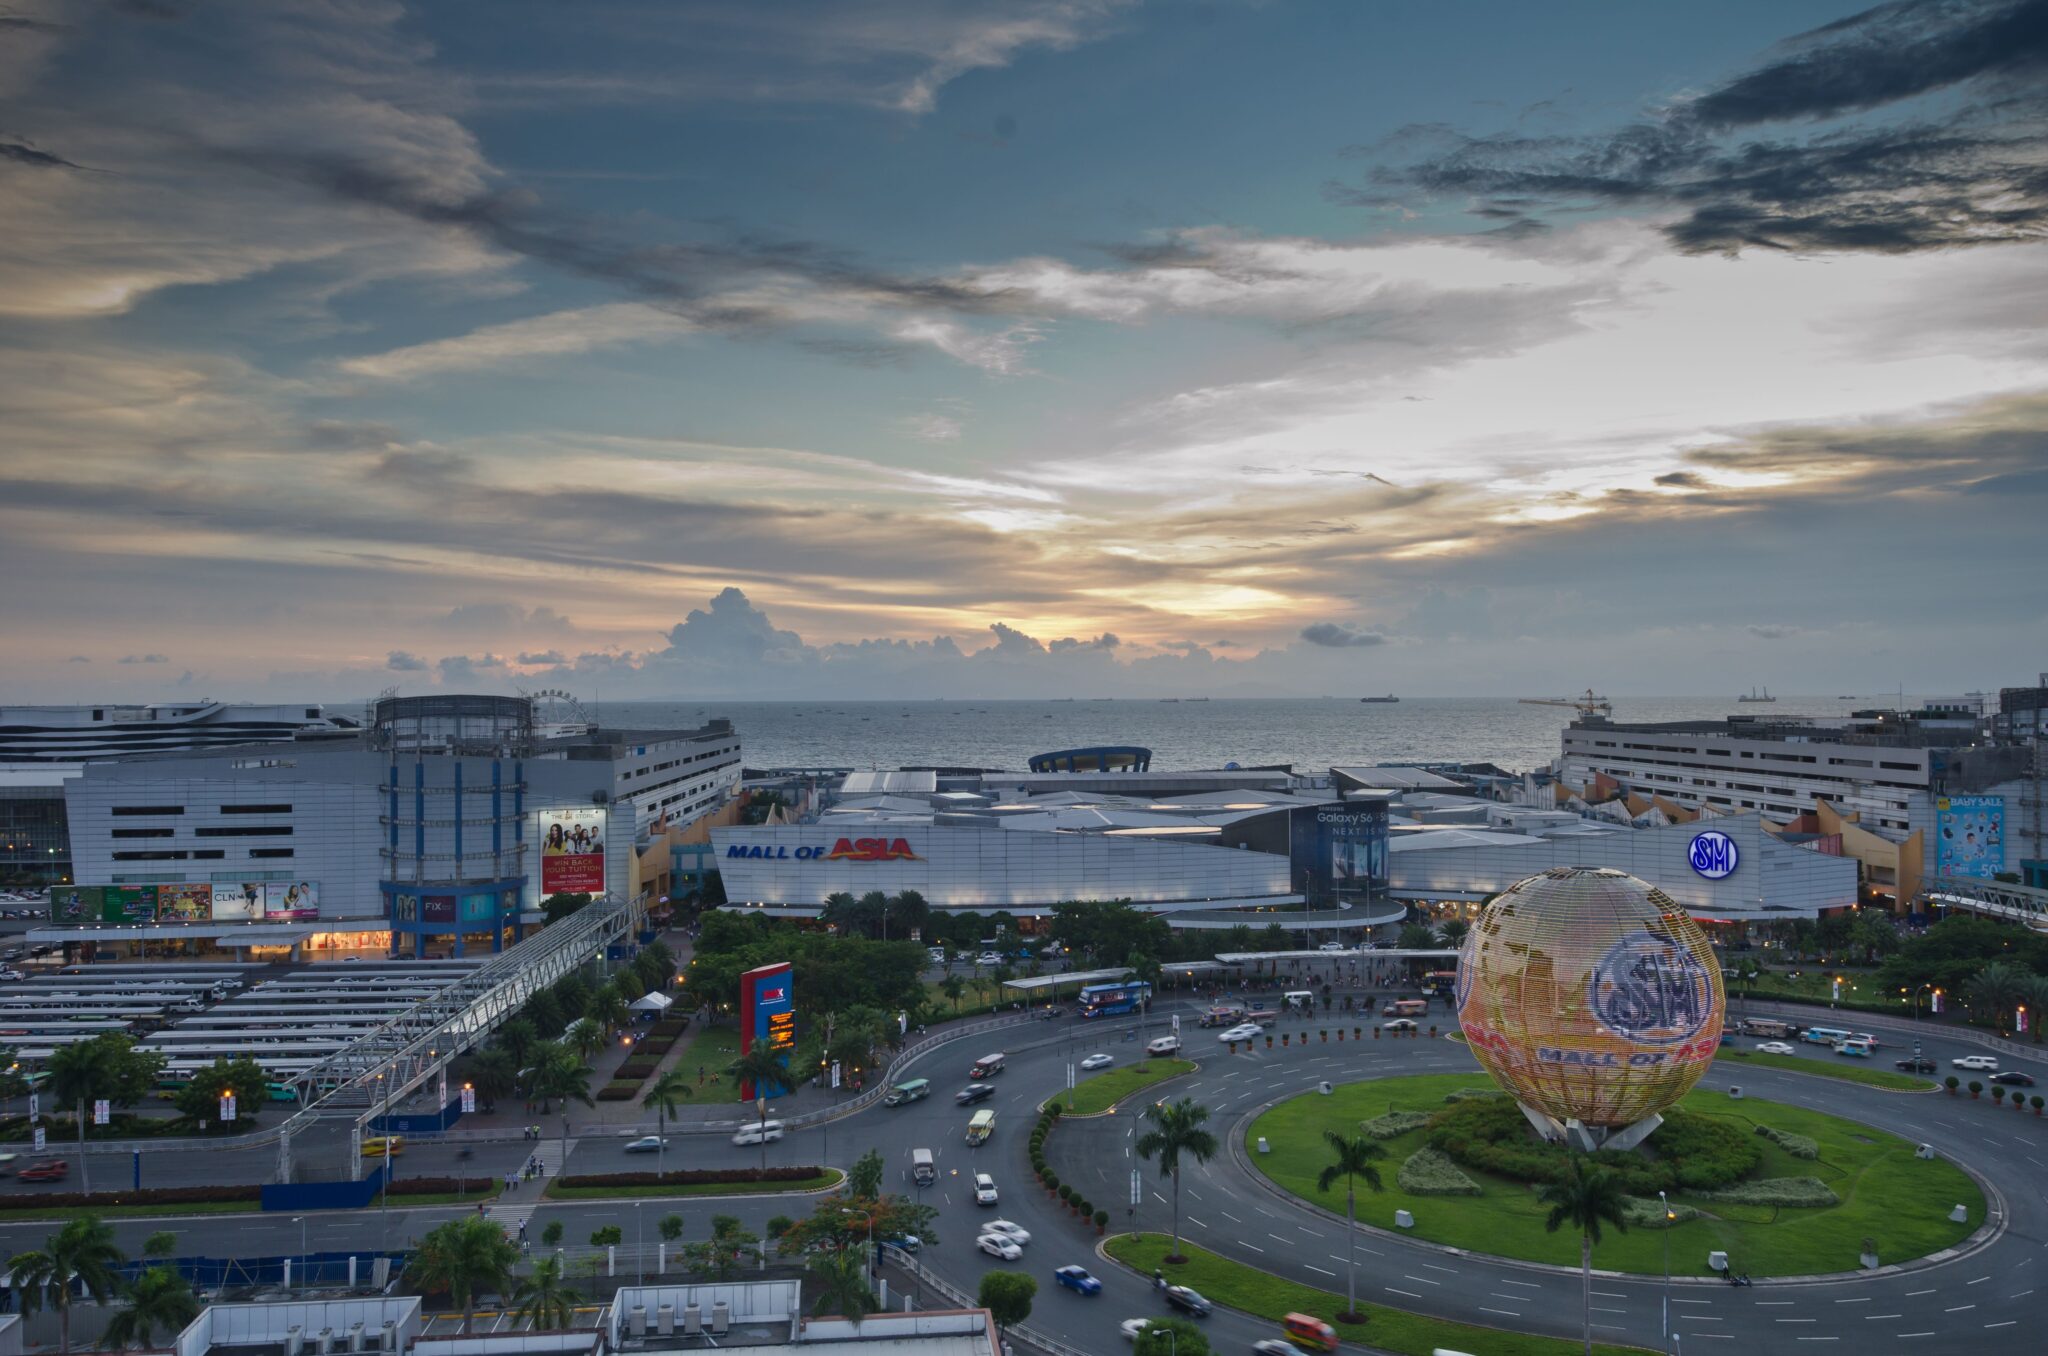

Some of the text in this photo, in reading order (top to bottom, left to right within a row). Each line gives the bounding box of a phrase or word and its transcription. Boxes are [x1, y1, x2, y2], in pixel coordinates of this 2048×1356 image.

[1950, 797, 1977, 806] BABY
[1978, 797, 2003, 806] SALE
[1317, 812, 1359, 826] Galaxy
[1360, 813, 1373, 823] S6
[1332, 827, 1361, 836] NEXT
[726, 837, 918, 861] MALL OF ASIA
[1692, 836, 1730, 871] SM
[569, 865, 600, 873] TUITION
[214, 893, 236, 902] CLN
[1538, 1047, 1618, 1066] MALL
